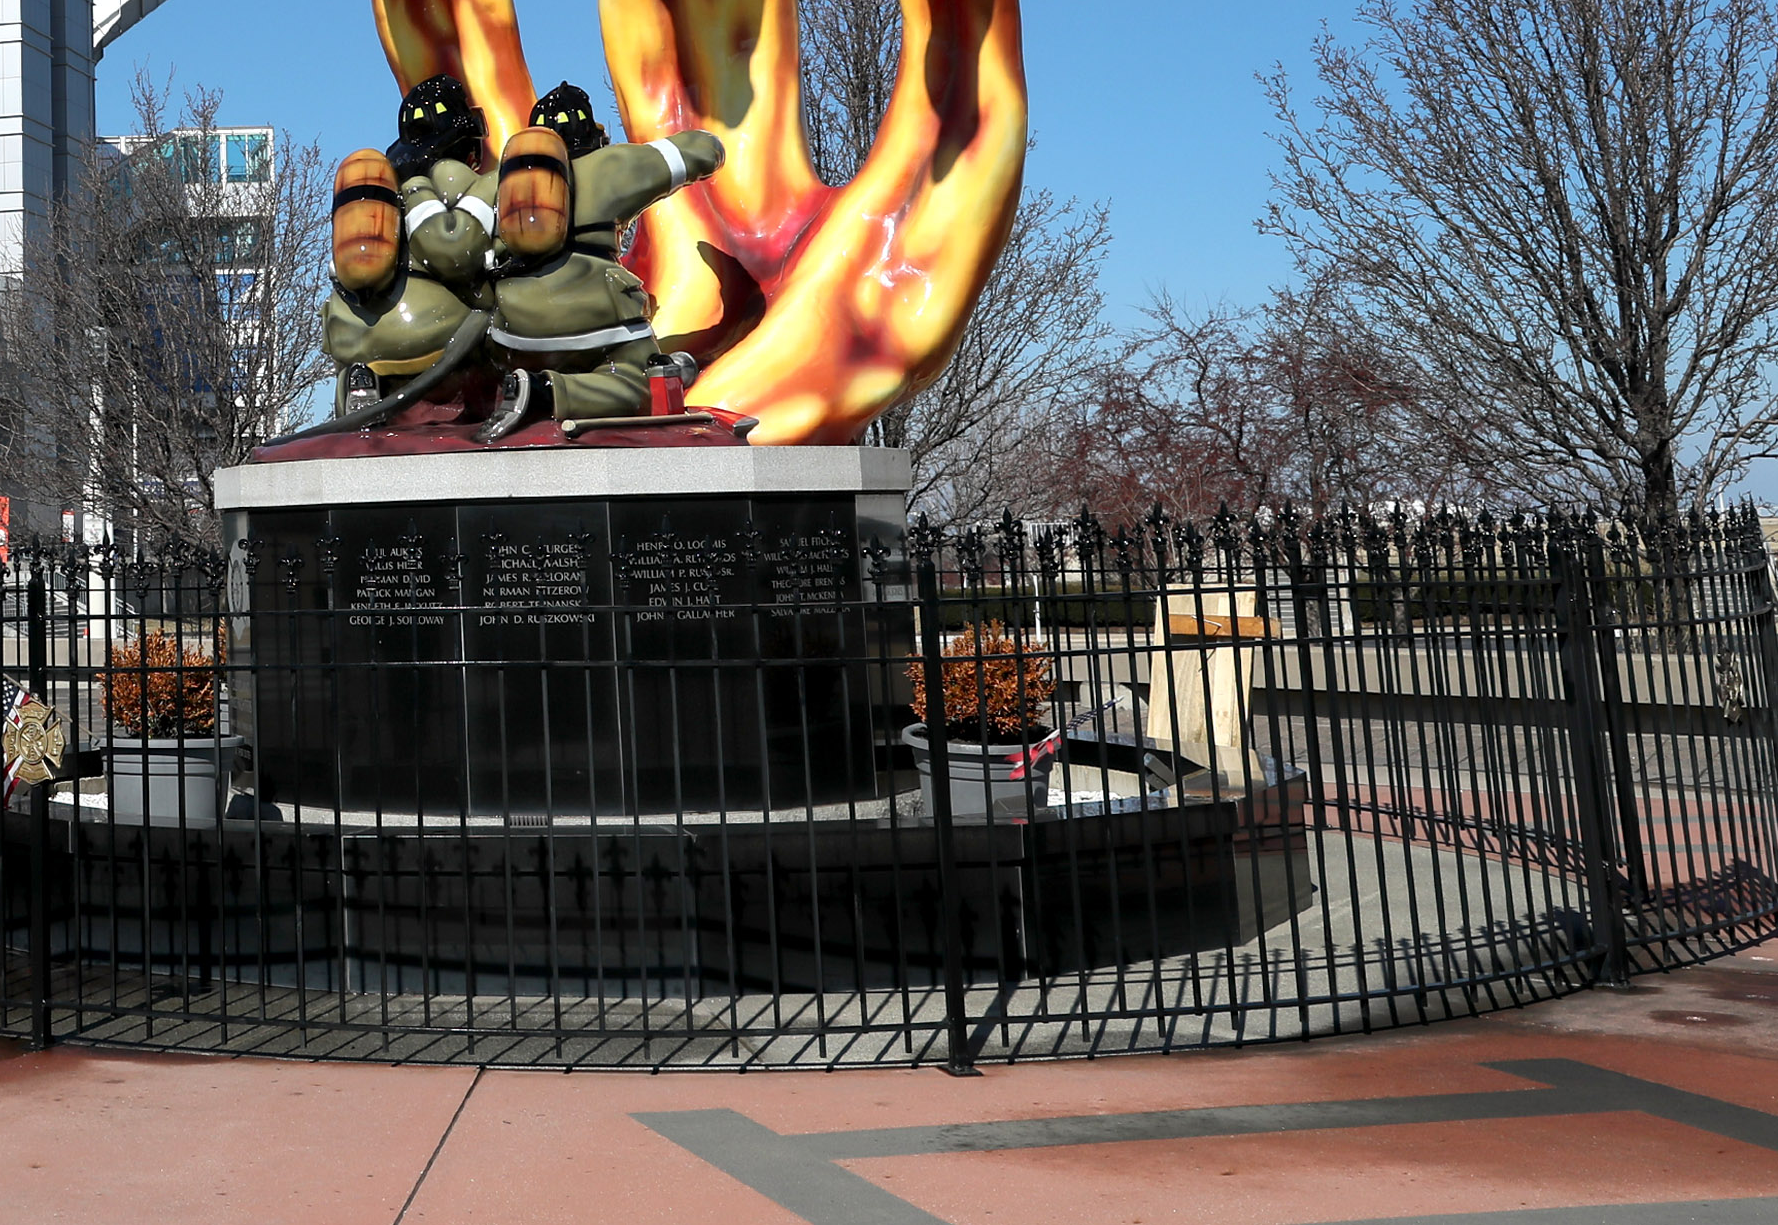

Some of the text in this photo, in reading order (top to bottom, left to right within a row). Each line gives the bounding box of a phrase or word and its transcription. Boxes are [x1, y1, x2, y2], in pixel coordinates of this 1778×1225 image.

[637, 542, 668, 551] HENR
[498, 559, 538, 568] ICHAL
[629, 556, 668, 565] ILLIA
[403, 575, 431, 583] DVID
[772, 579, 812, 589] THEOORE
[395, 588, 435, 597] MAGAN
[696, 595, 721, 605] HAT
[637, 612, 664, 622] JOHN
[677, 610, 735, 620] GALLAHER
